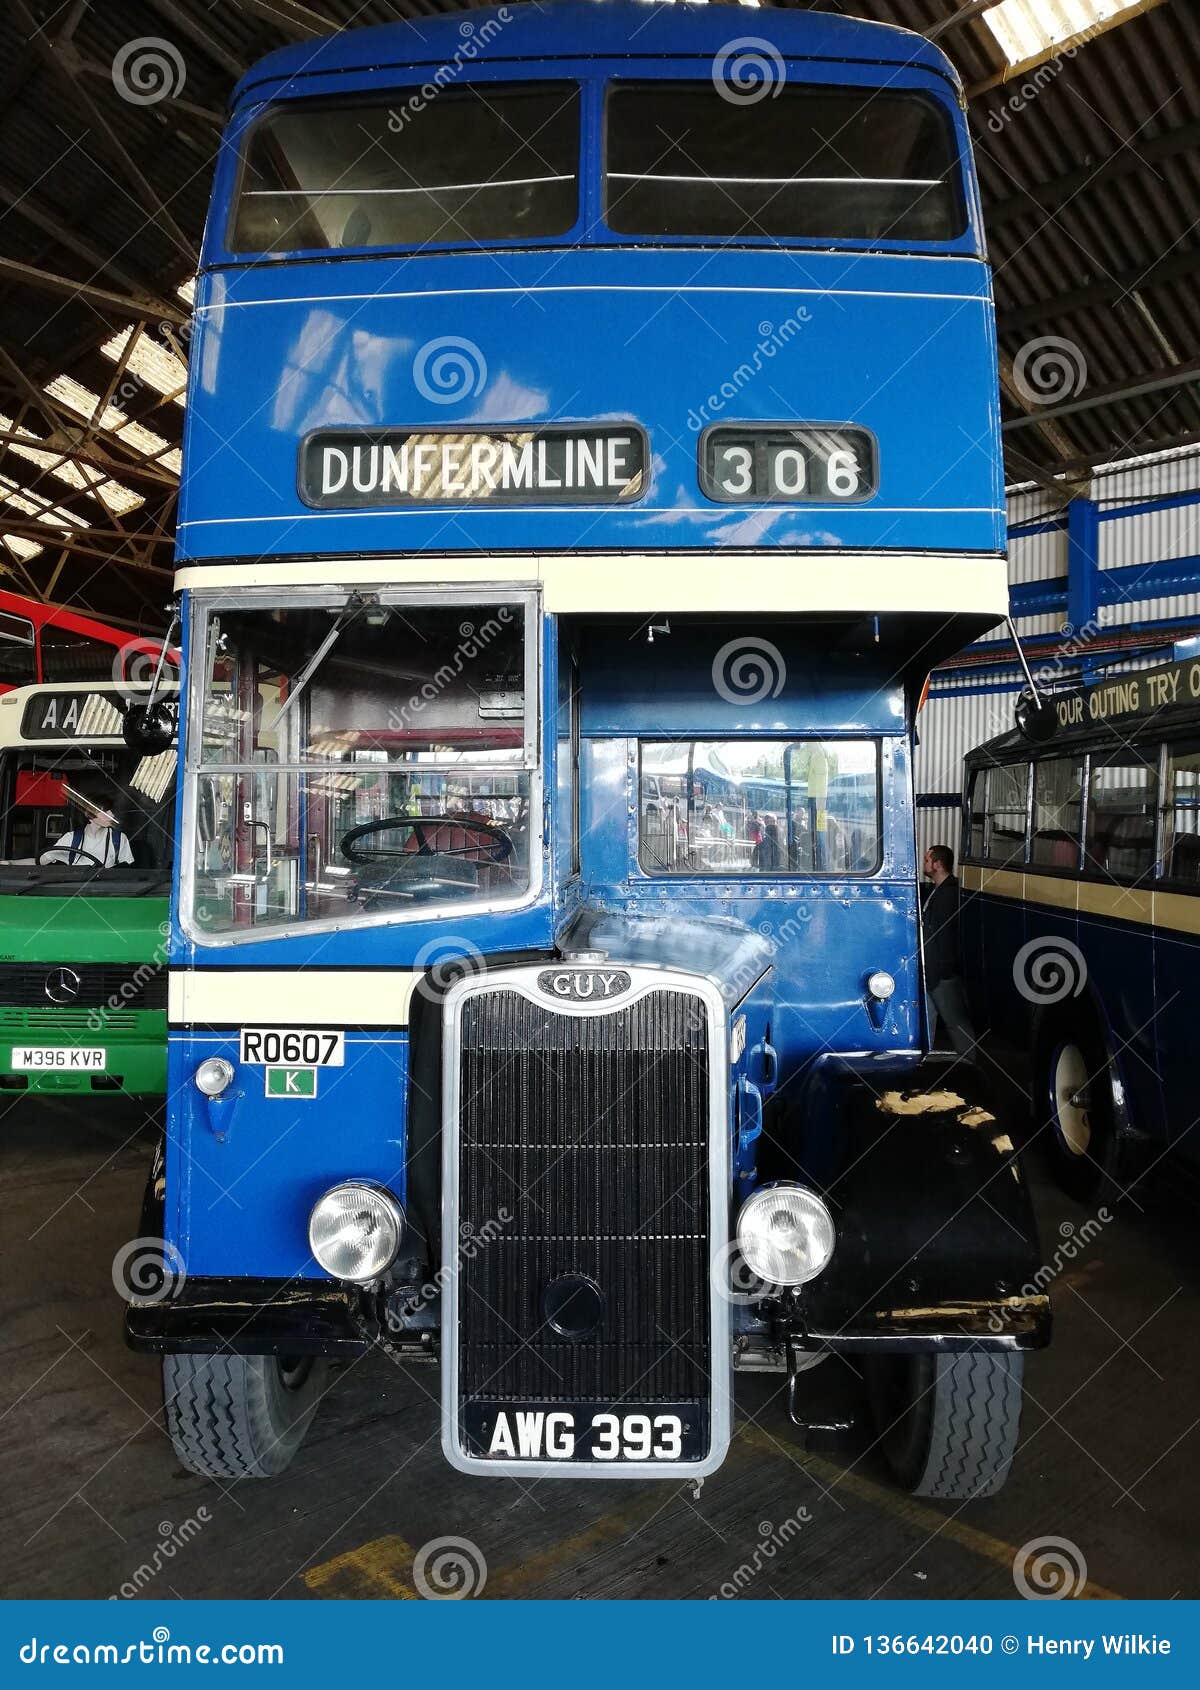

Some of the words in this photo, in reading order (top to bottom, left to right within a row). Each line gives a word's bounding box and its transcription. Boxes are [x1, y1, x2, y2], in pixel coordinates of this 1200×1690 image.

[322, 437, 631, 494] DUNFERMLINE
[722, 446, 859, 497] 306
[1056, 697, 1083, 726] OUR
[1089, 681, 1140, 719] OUTING
[1146, 669, 1181, 706] TRY
[553, 974, 617, 998] GUY
[23, 1051, 65, 1066] M396
[70, 1051, 103, 1066] KVR
[285, 1071, 299, 1092] K
[489, 1411, 575, 1458] AWG
[591, 1413, 682, 1459] 393
